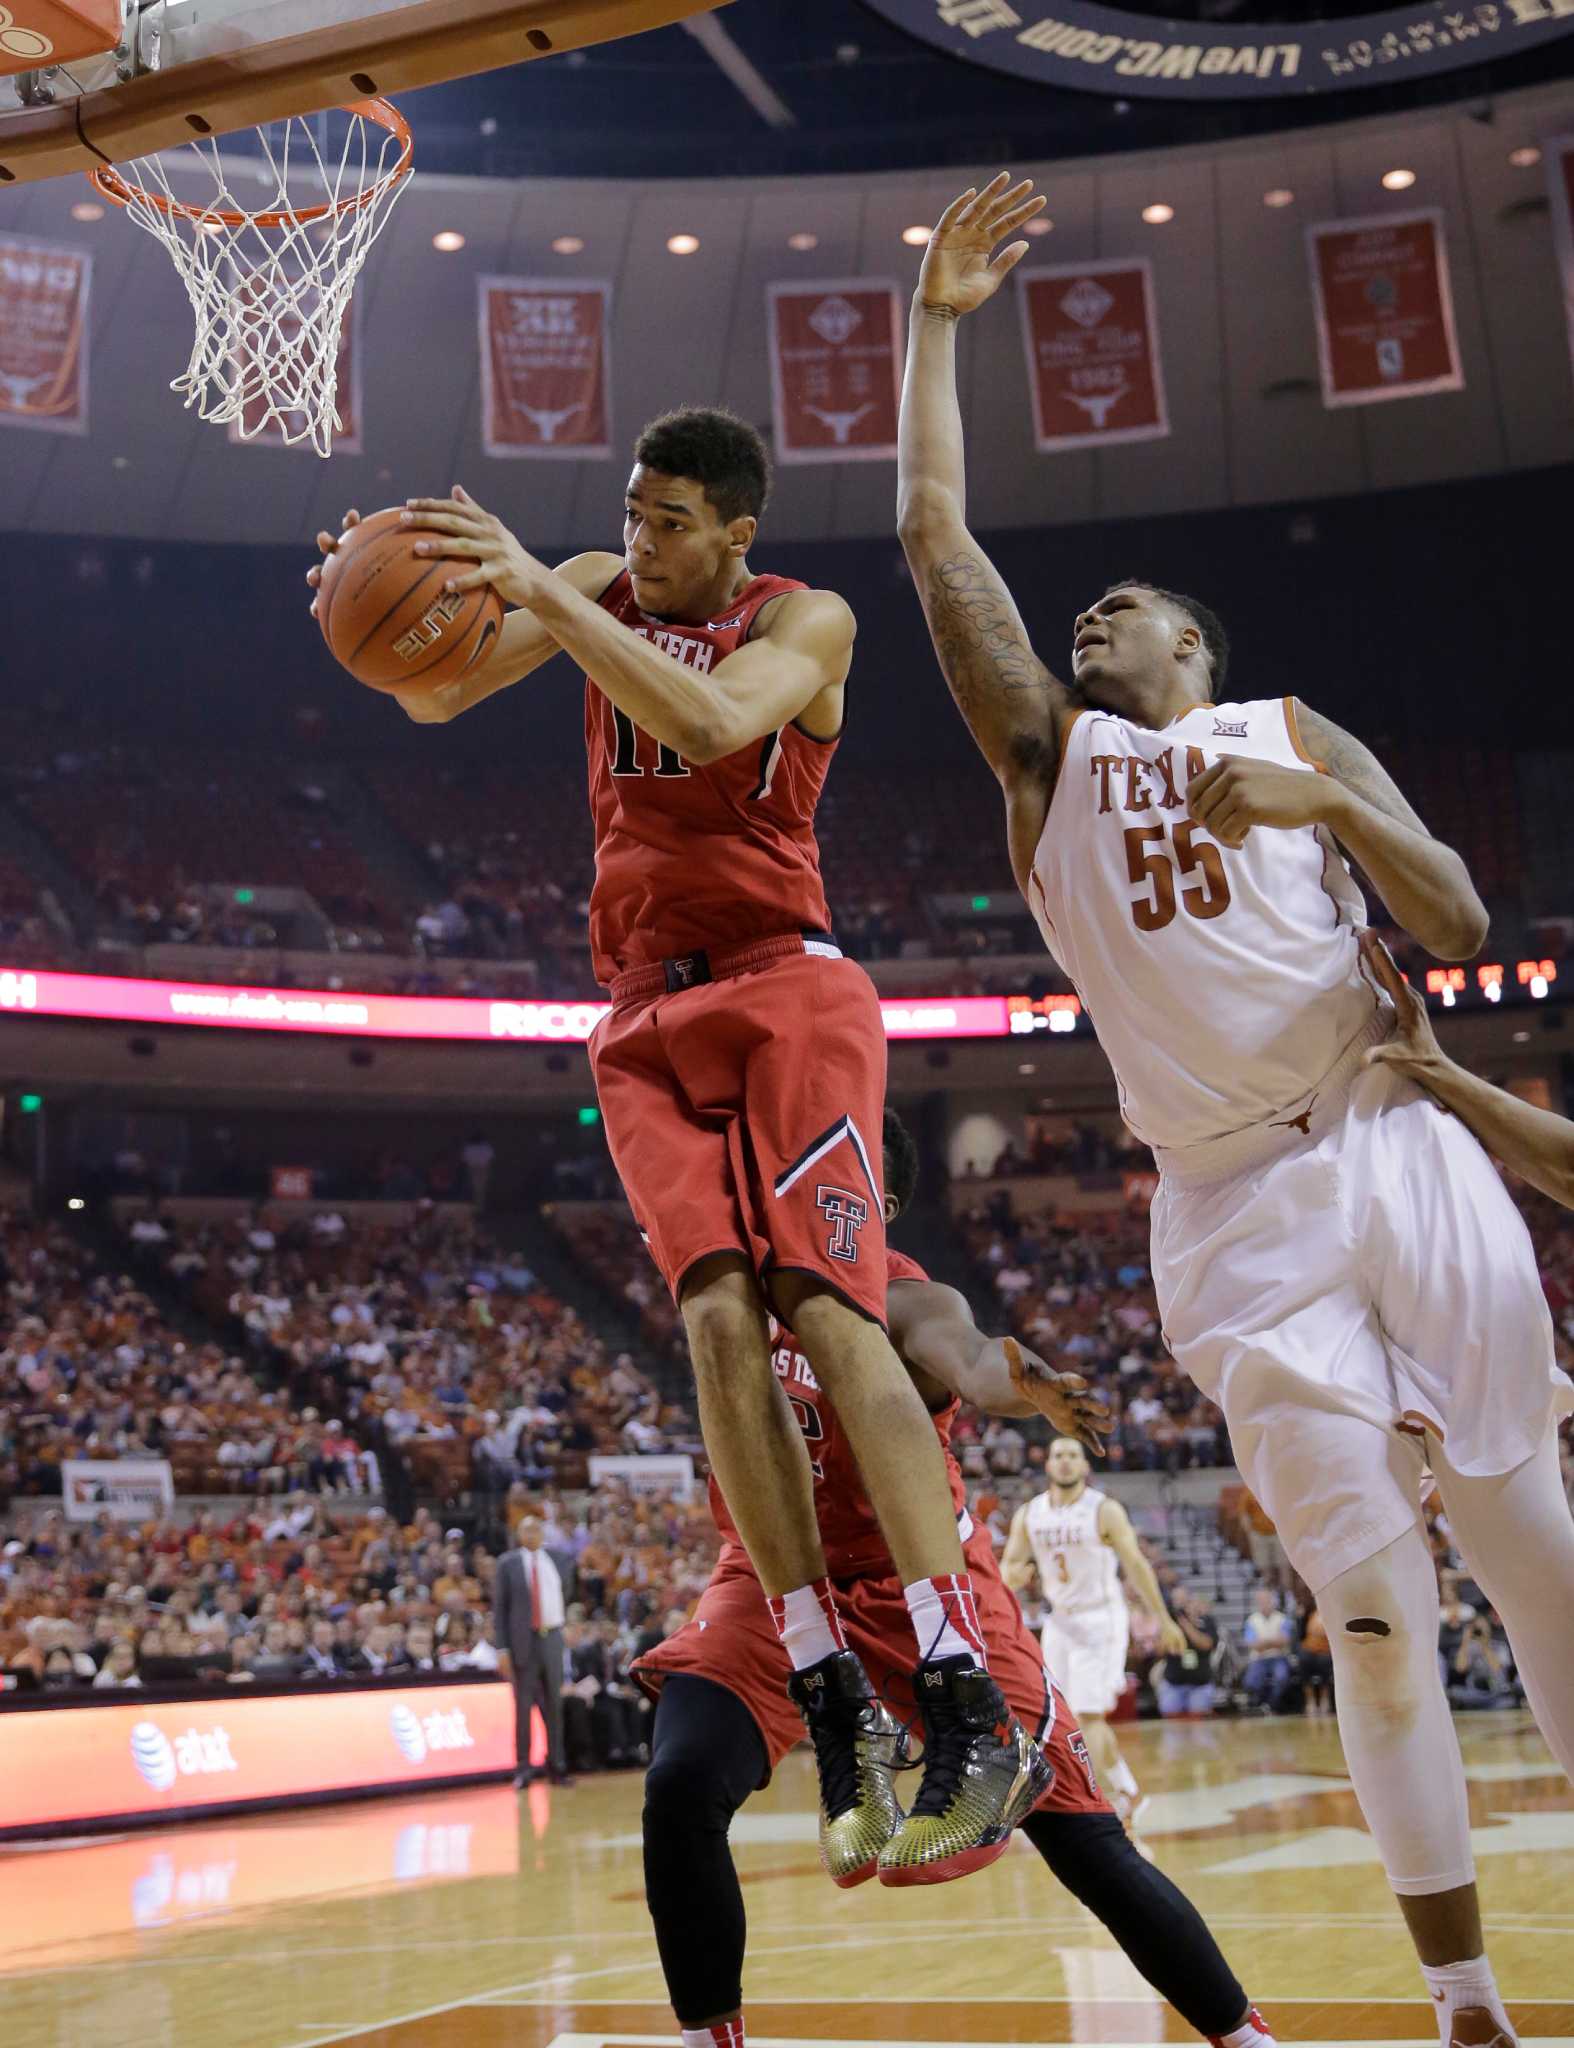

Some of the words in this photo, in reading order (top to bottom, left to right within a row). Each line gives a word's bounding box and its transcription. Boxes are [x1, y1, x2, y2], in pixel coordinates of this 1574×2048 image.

[1016, 18, 1301, 79] LiveWC.com
[653, 629, 714, 676] TECH
[1090, 745, 1207, 815] TEXA
[1124, 818, 1231, 932] 55
[489, 1002, 612, 1038] RICO
